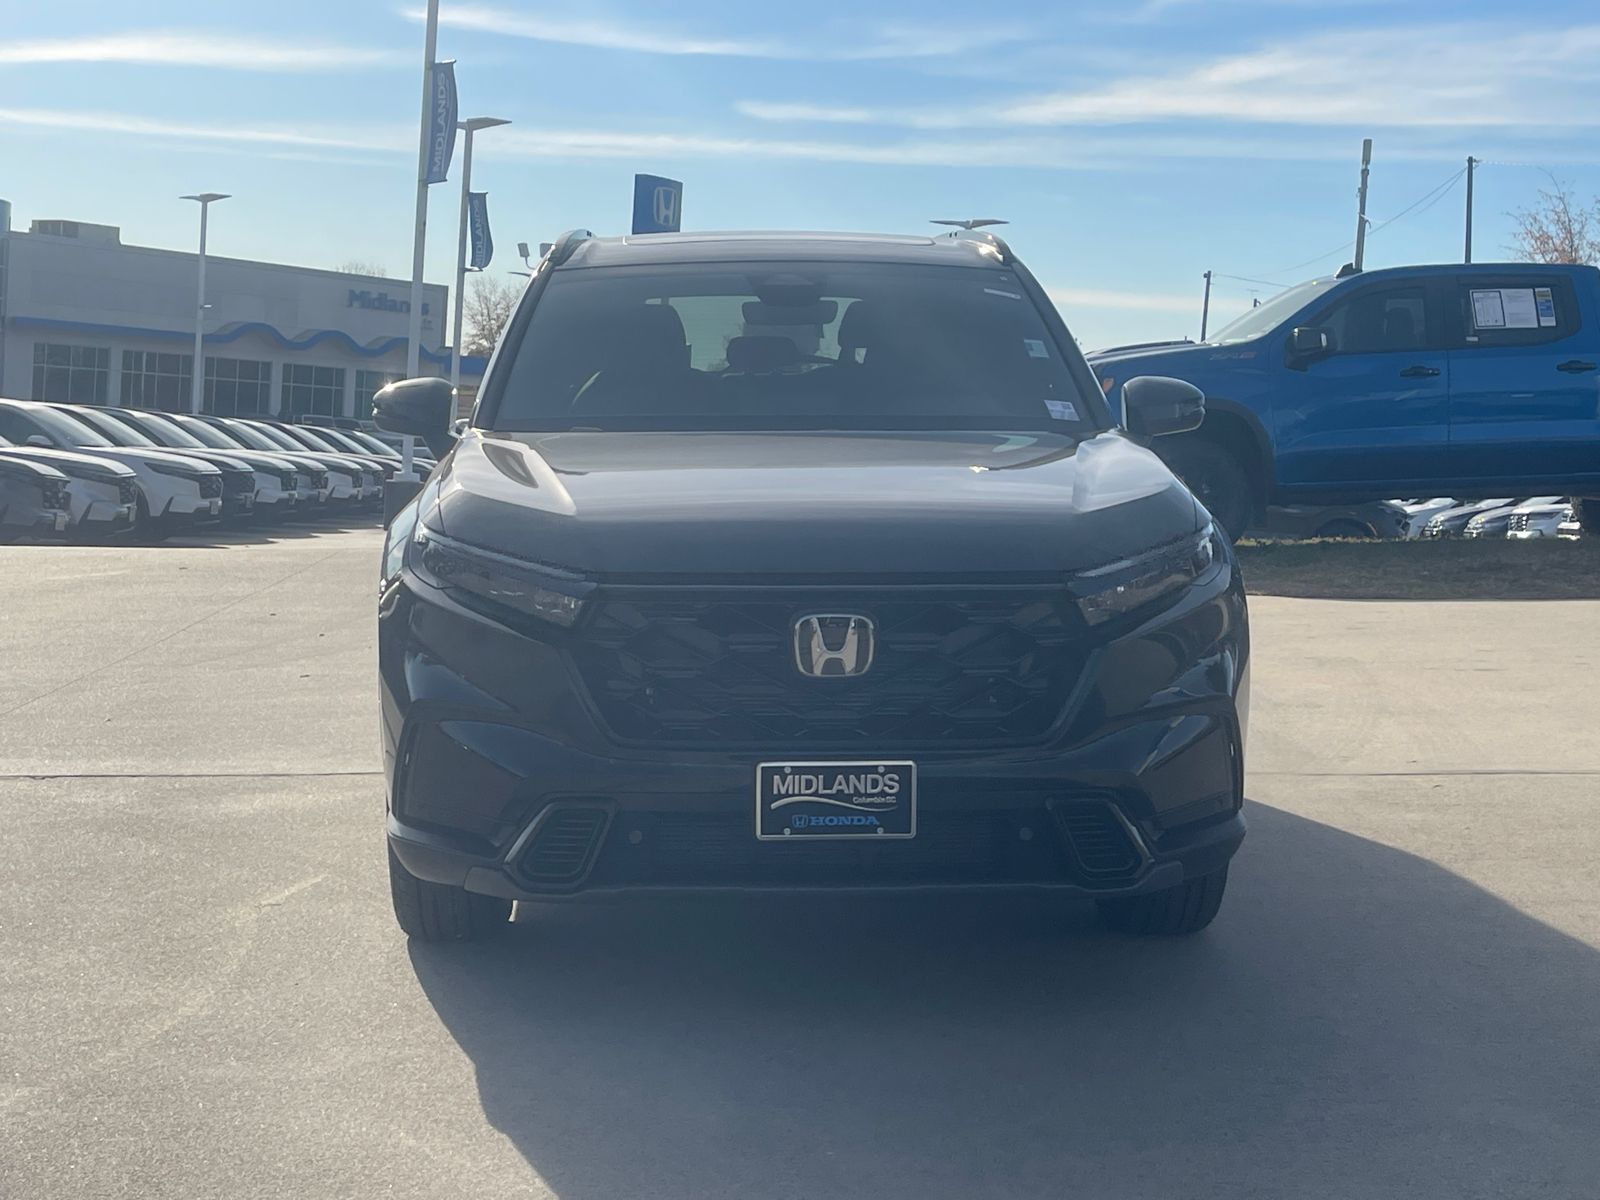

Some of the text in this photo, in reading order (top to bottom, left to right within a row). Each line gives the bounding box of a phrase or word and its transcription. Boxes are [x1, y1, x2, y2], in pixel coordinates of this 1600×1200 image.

[433, 72, 446, 173] MIDLANDS
[473, 199, 484, 267] MIDLANDS
[347, 288, 430, 316] Midlans
[773, 773, 900, 795] MIDLANDS
[809, 815, 881, 826] HONDA
